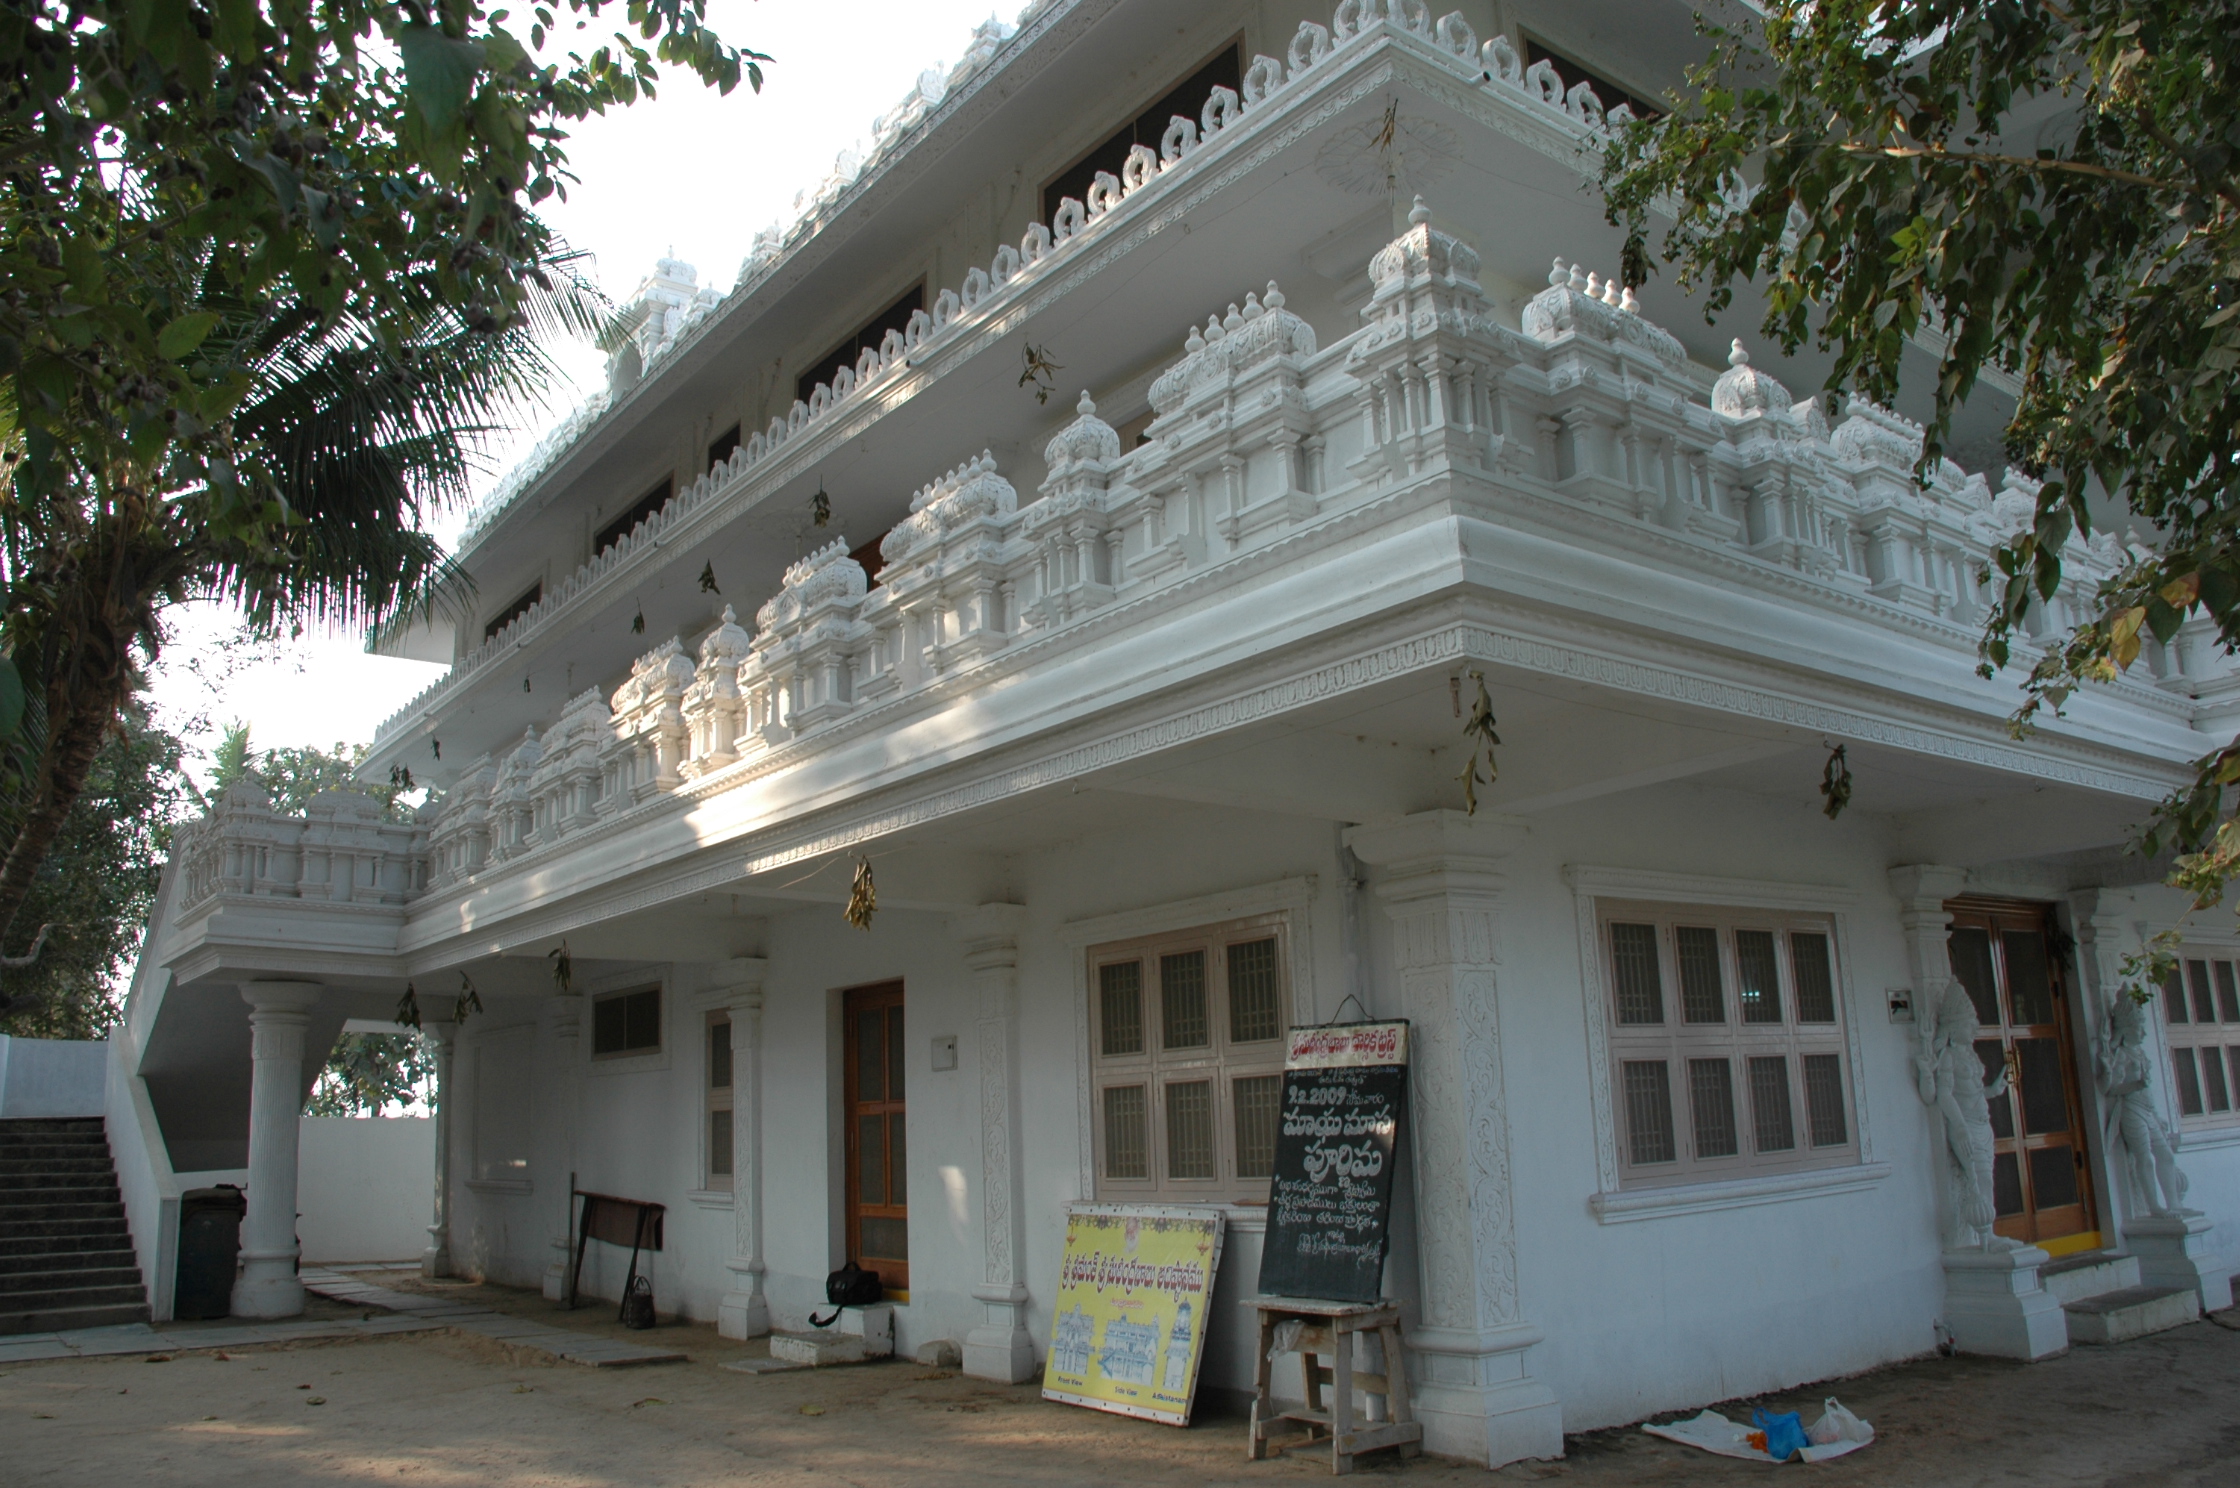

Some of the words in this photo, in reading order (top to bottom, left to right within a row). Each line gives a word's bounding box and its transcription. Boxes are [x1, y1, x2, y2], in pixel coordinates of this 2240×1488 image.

[1288, 1085, 1347, 1105] 9.2.2009
[1343, 1104, 1391, 1135] మాస
[1303, 1140, 1383, 1188] పూర్ణిమ
